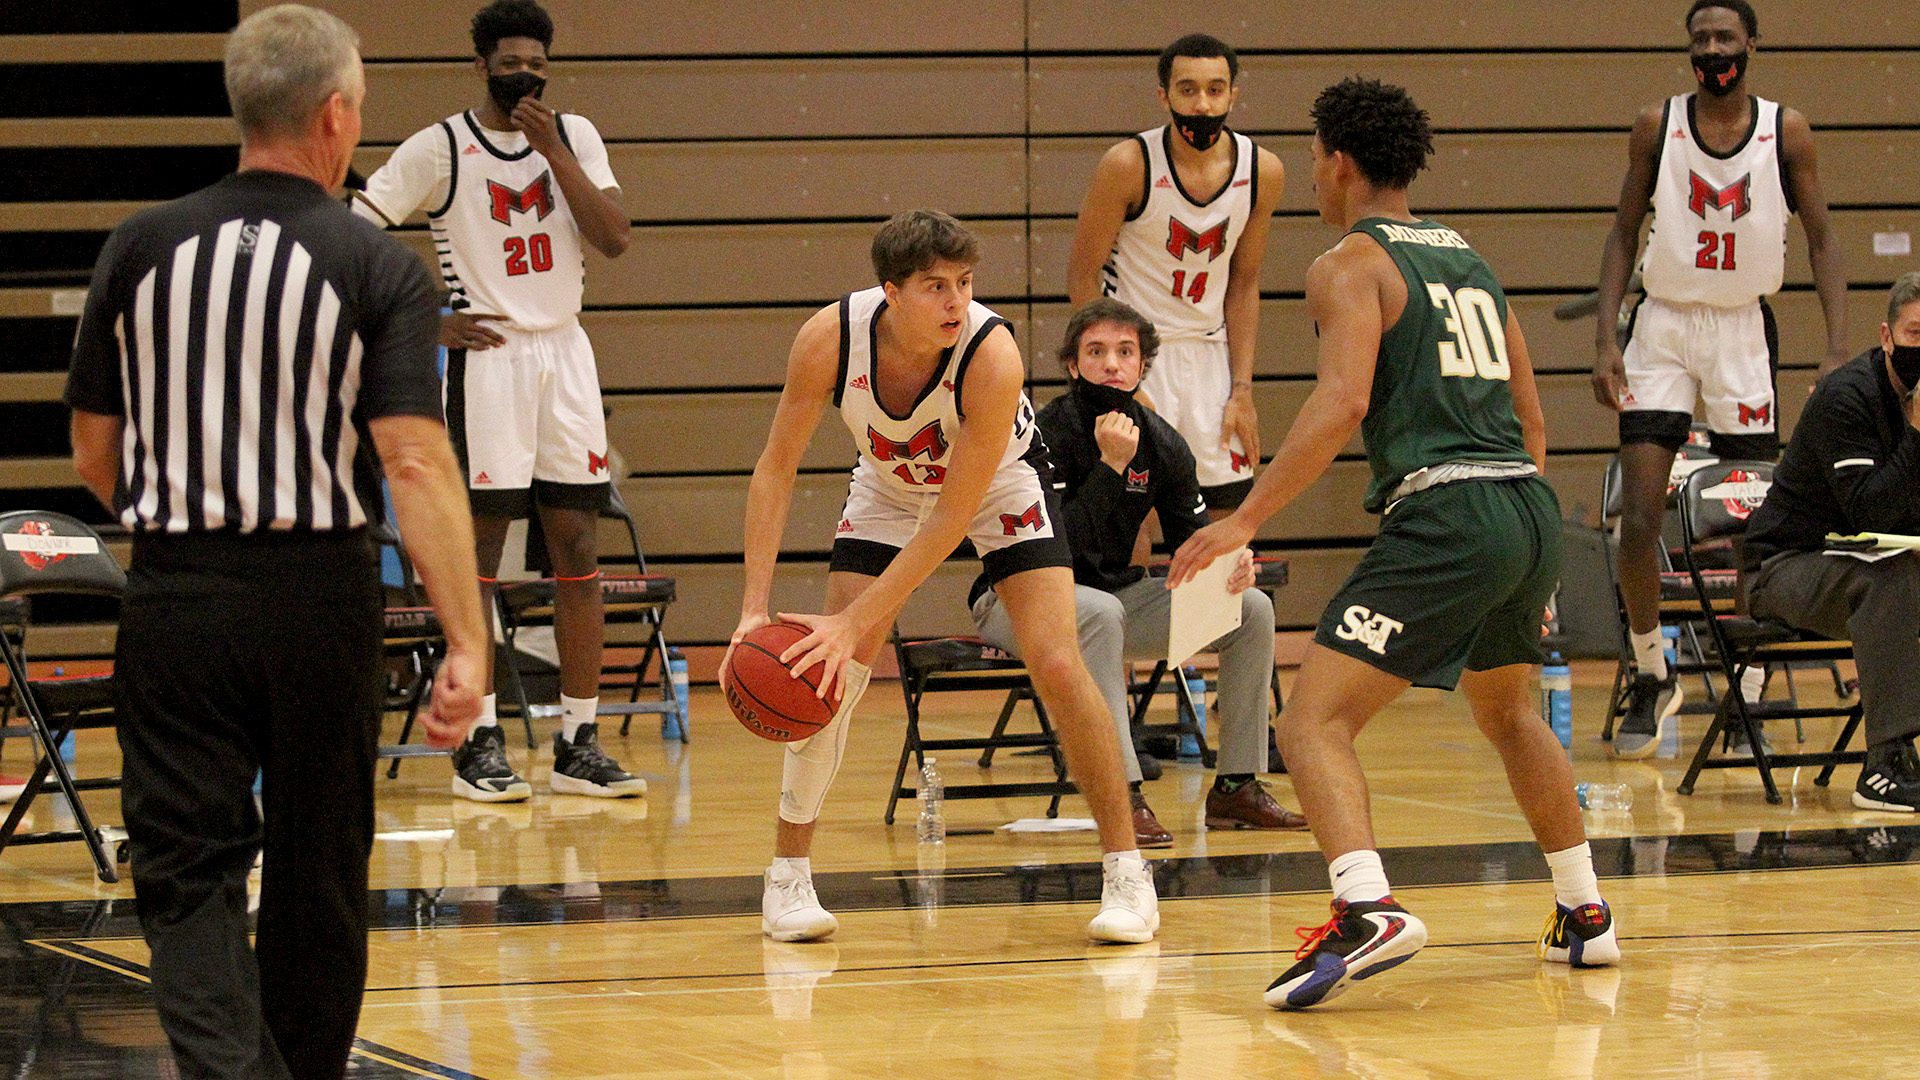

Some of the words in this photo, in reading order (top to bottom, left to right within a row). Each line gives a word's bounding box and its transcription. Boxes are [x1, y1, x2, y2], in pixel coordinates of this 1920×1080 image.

[486, 168, 556, 227] M
[1689, 168, 1751, 222] M
[503, 232, 553, 276] 20
[1166, 215, 1230, 263] M
[1376, 224, 1470, 249] MINERS
[1695, 230, 1736, 270] 21
[1171, 269, 1208, 304] 14
[1425, 281, 1511, 381] 30
[1737, 400, 1770, 427] M
[867, 418, 949, 461] M
[999, 500, 1045, 536] M
[1335, 604, 1404, 655] S&T
[728, 682, 790, 738] Wilson
